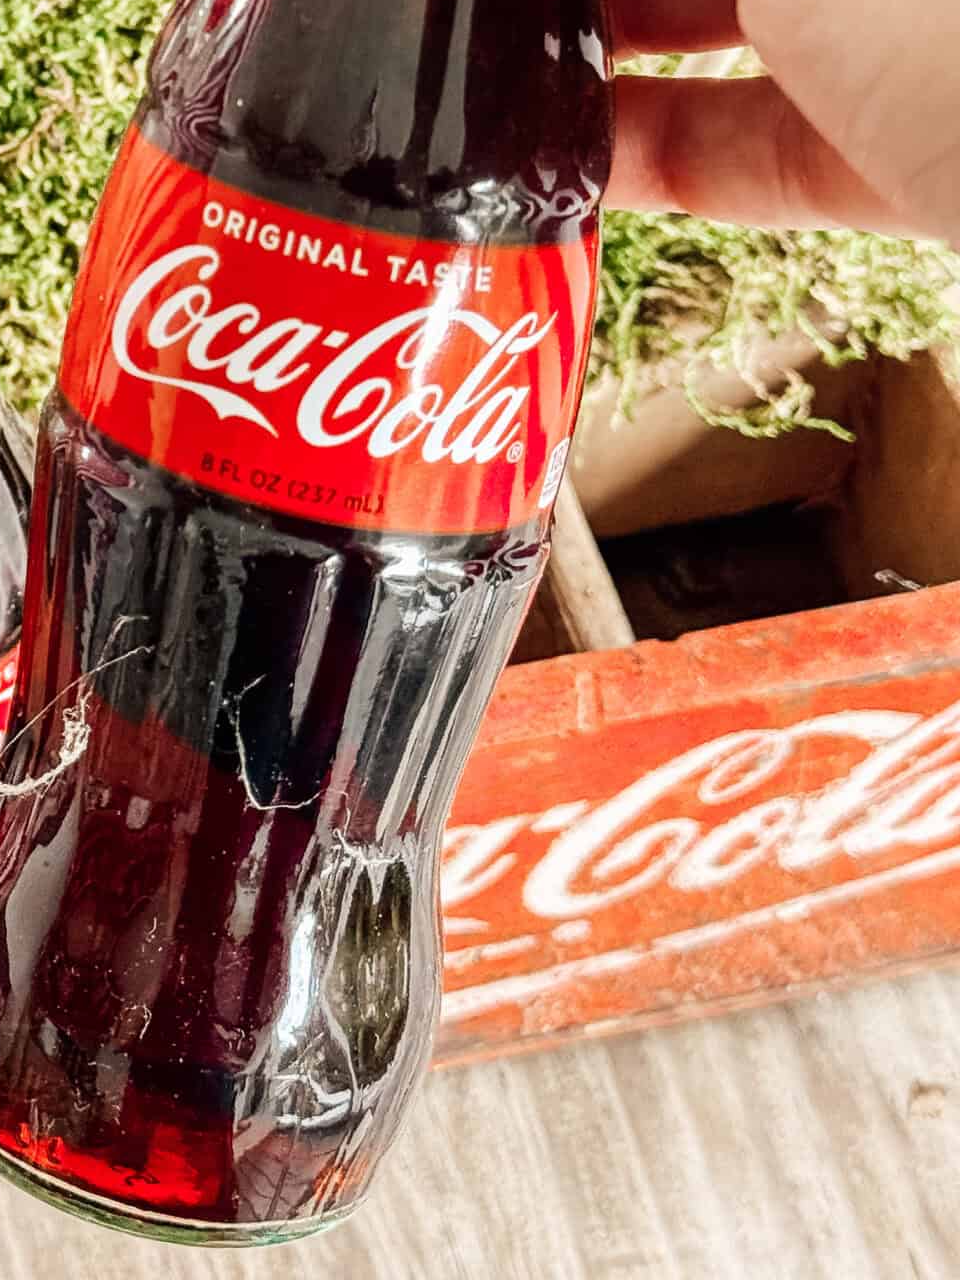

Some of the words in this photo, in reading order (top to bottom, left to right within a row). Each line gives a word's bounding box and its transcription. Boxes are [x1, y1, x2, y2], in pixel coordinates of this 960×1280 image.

[201, 200, 370, 278] ORIGINAL
[386, 254, 493, 294] TASTE
[112, 244, 558, 465] Coca-Cola
[200, 451, 216, 473] 8
[219, 458, 242, 482] FL
[249, 468, 282, 494] OZ
[287, 479, 337, 505] (237
[343, 493, 386, 516] mL)
